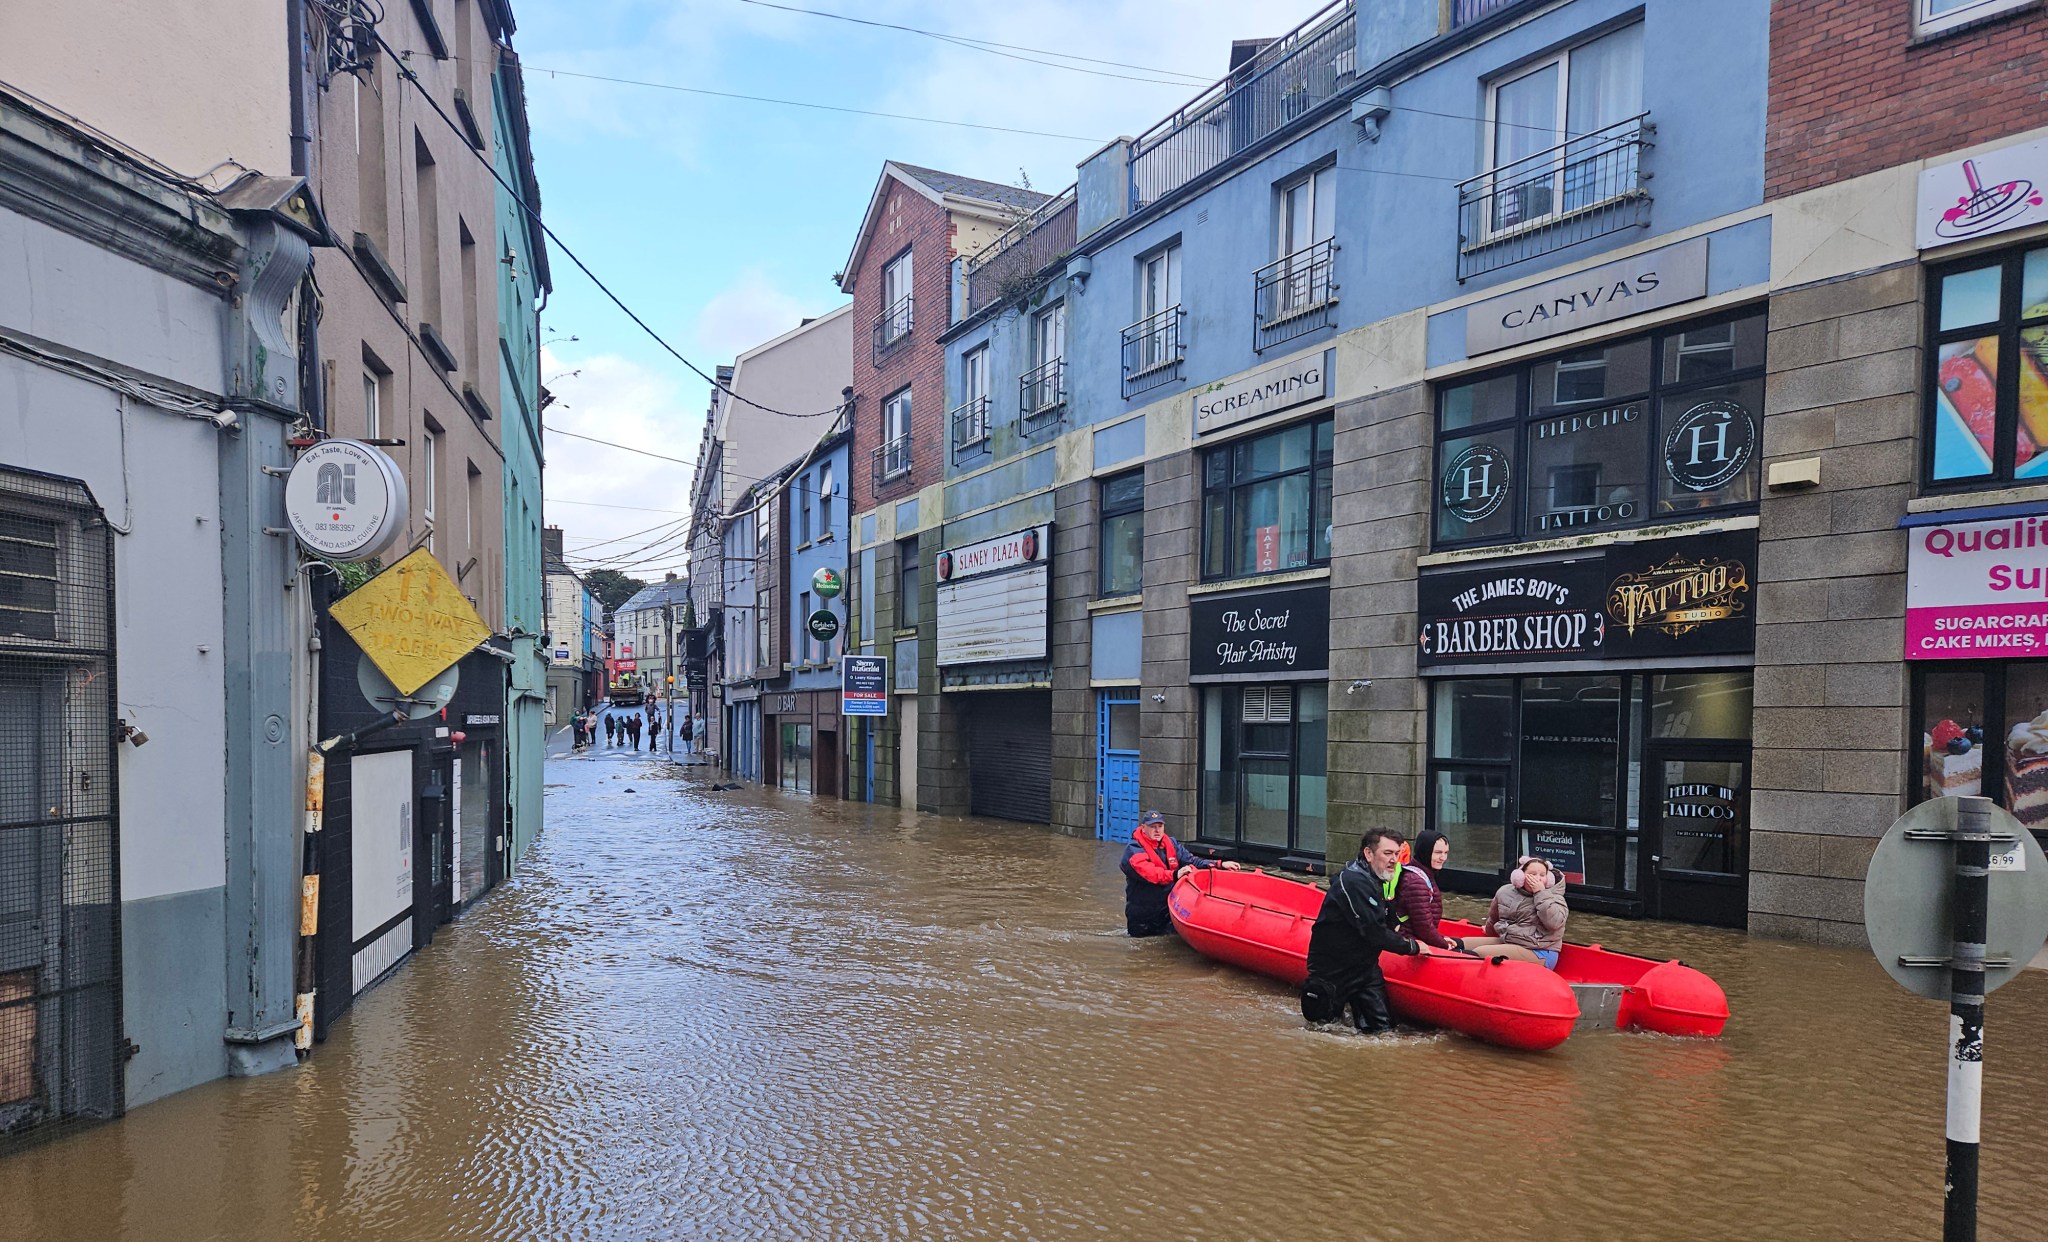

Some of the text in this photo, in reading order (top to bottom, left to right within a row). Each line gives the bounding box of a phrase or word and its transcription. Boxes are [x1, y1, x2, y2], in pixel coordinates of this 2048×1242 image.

[1501, 271, 1660, 329] CANVAS
[1199, 368, 1320, 420] SCREAMING
[1539, 405, 1639, 439] PIERCING
[305, 446, 370, 466] Eat, Taste, Love ai
[1685, 421, 1733, 466] H
[1459, 463, 1493, 501] H
[292, 511, 379, 549] JAPANESE AND ASIAN CUISINE
[1539, 502, 1633, 530] TATTOO
[959, 541, 1019, 570] SLANEY PLAZA
[1674, 566, 1701, 574] WINNING
[1988, 564, 2048, 598] Su
[1451, 577, 1569, 613] THE JAMES BOY'S
[1615, 566, 1727, 638] TATTOO
[366, 601, 464, 632] TWO-WAY
[812, 620, 836, 631] Carlsberg
[1222, 607, 1290, 633] The Secret
[1676, 610, 1722, 620] STUDIO
[1435, 612, 1588, 654] BARBER SHOP
[1920, 635, 1971, 649] CAKE
[1975, 633, 2040, 648] MIXES,
[1216, 639, 1298, 666] Hair Artistry
[783, 695, 796, 711] BAR
[1669, 784, 1715, 799] HERETIC
[1669, 802, 1734, 820] TATTOOS
[1535, 846, 1555, 854] O'Leary
[1536, 833, 1573, 845] FitzGerald
